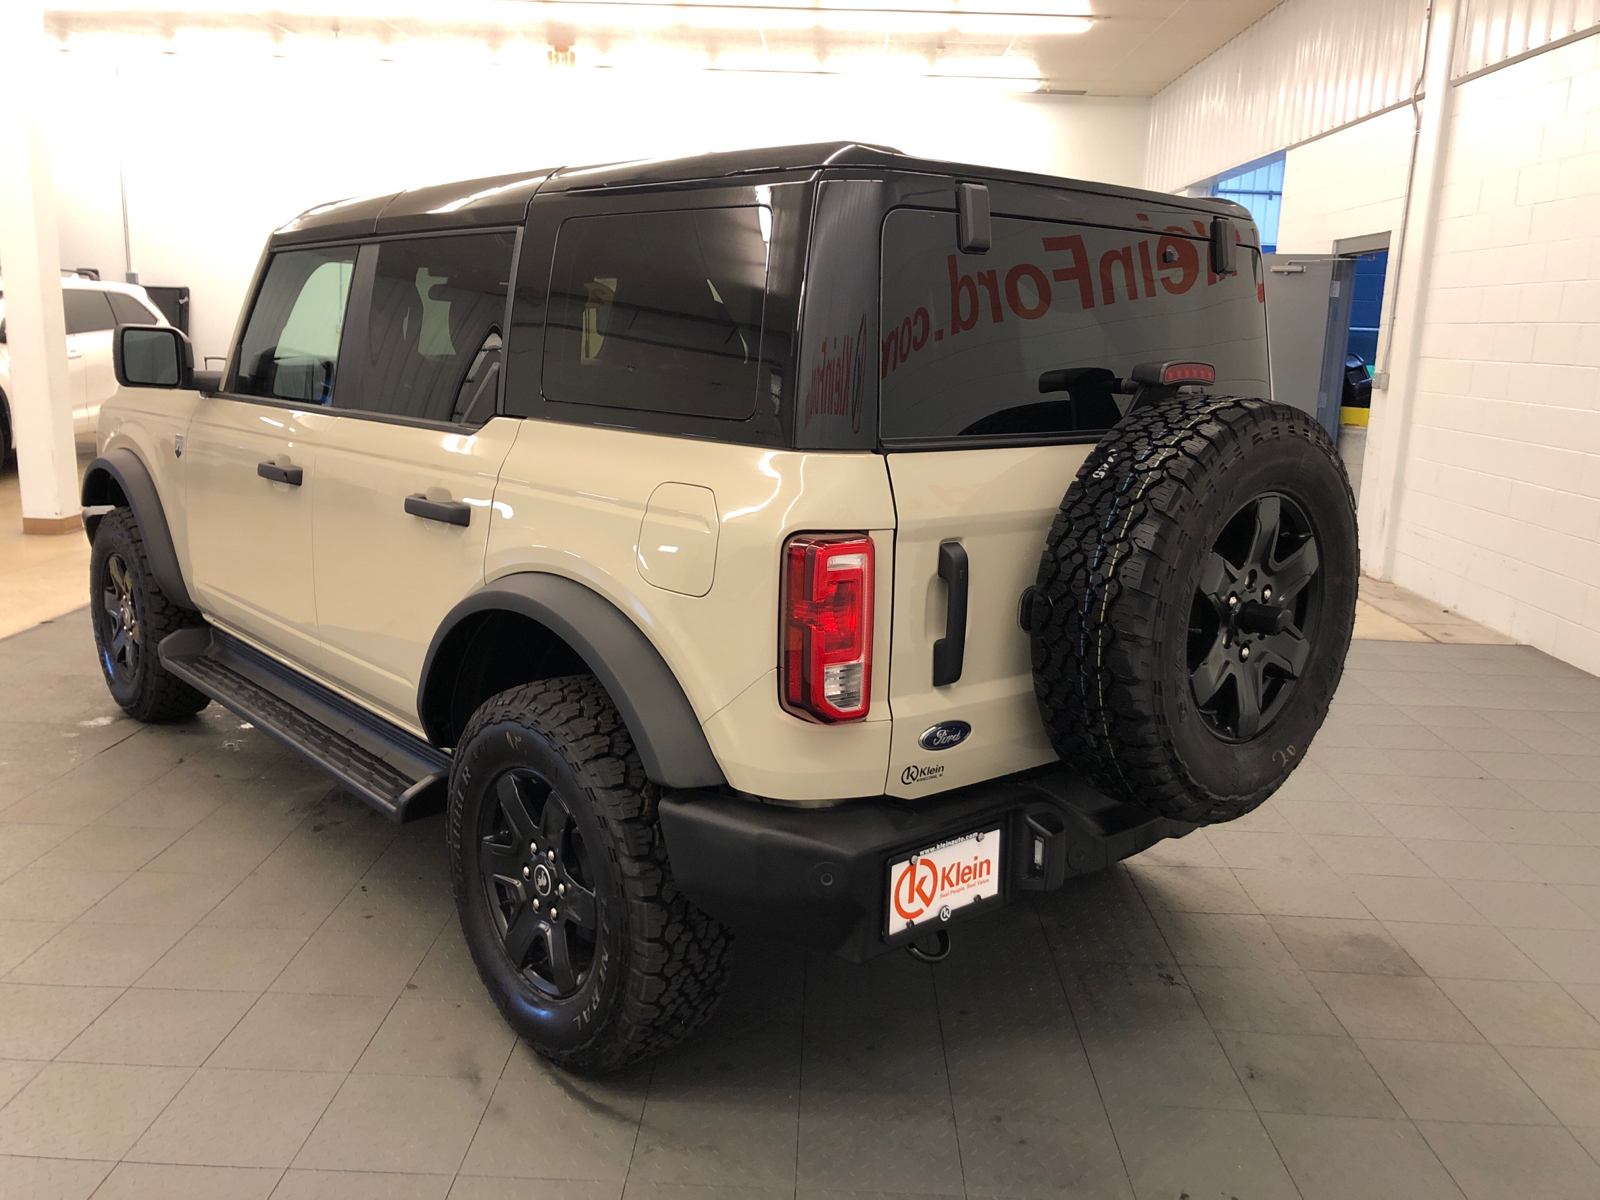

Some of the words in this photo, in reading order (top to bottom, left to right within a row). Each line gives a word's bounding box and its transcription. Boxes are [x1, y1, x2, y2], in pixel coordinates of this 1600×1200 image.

[933, 729, 962, 746] Ford
[919, 764, 945, 777] Klein
[919, 832, 978, 856] www.kleinauto.com
[941, 855, 991, 891] Klein
[940, 890, 950, 898] Real
[967, 881, 977, 889] Real
